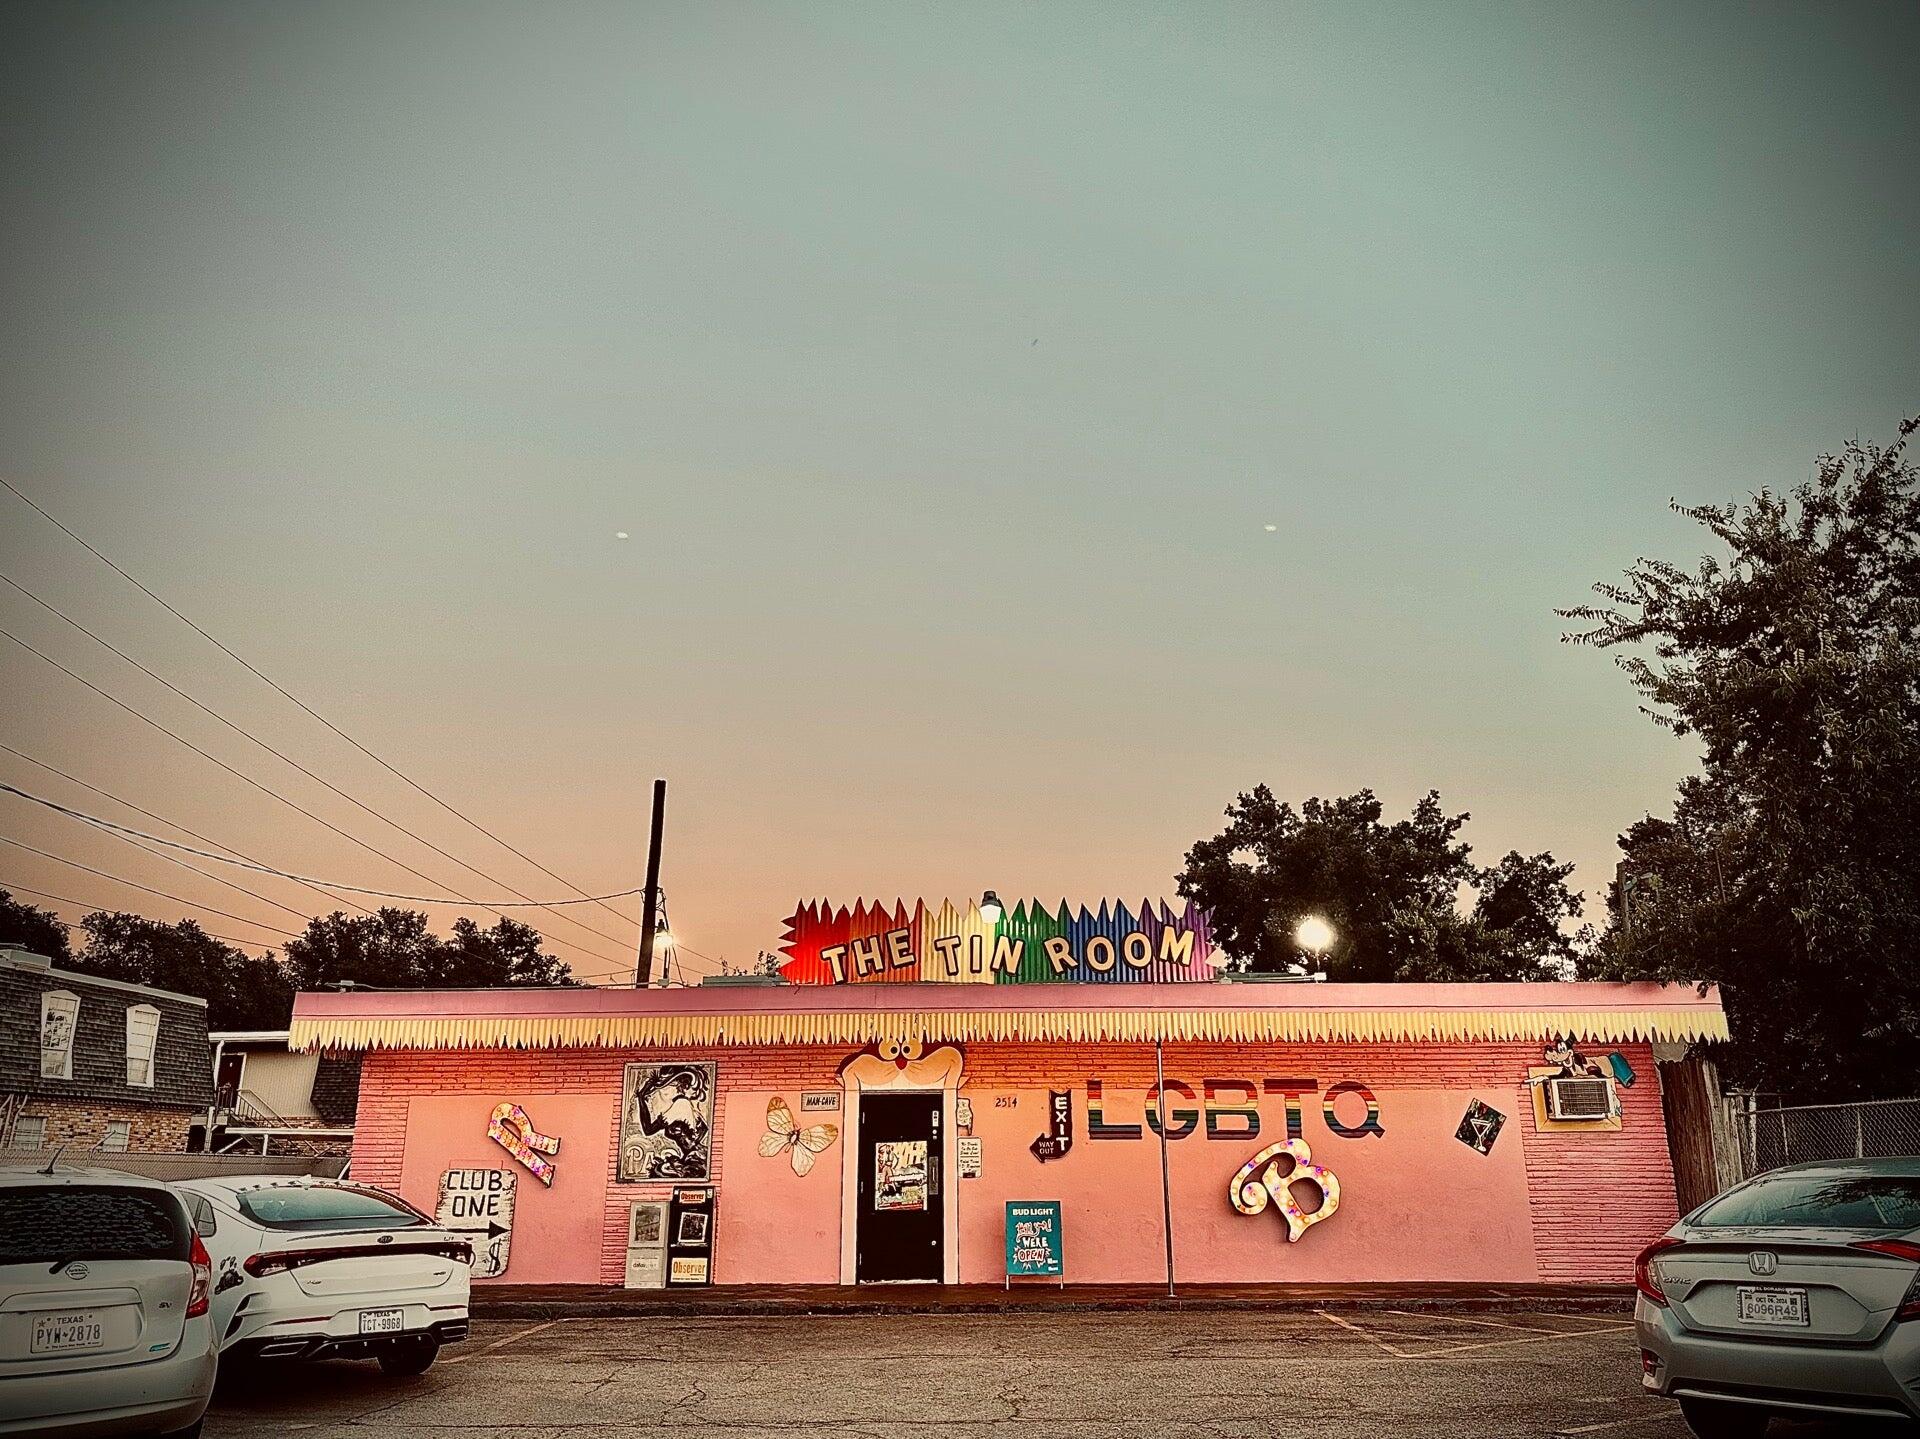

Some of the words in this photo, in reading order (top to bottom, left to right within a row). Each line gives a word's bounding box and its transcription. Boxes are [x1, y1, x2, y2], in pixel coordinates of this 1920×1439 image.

[821, 926, 916, 985] THE
[935, 933, 1023, 976] TIN
[1044, 925, 1196, 975] ROOM
[995, 1096, 1018, 1108] 2514
[1087, 1078, 1386, 1141] LGBTQ
[1054, 1096, 1069, 1151] EXIT
[1039, 1147, 1055, 1155] OUT
[446, 1170, 503, 1192] CLUB
[680, 1192, 705, 1200] Observer
[452, 1194, 501, 1218] ONE
[1012, 1208, 1030, 1216] BUD
[1030, 1208, 1054, 1216] LIGHT
[1019, 1249, 1045, 1261] OPEN
[673, 1261, 706, 1274] Observer
[1747, 1302, 1798, 1316] 6096R49
[57, 1315, 84, 1325] TEXAS
